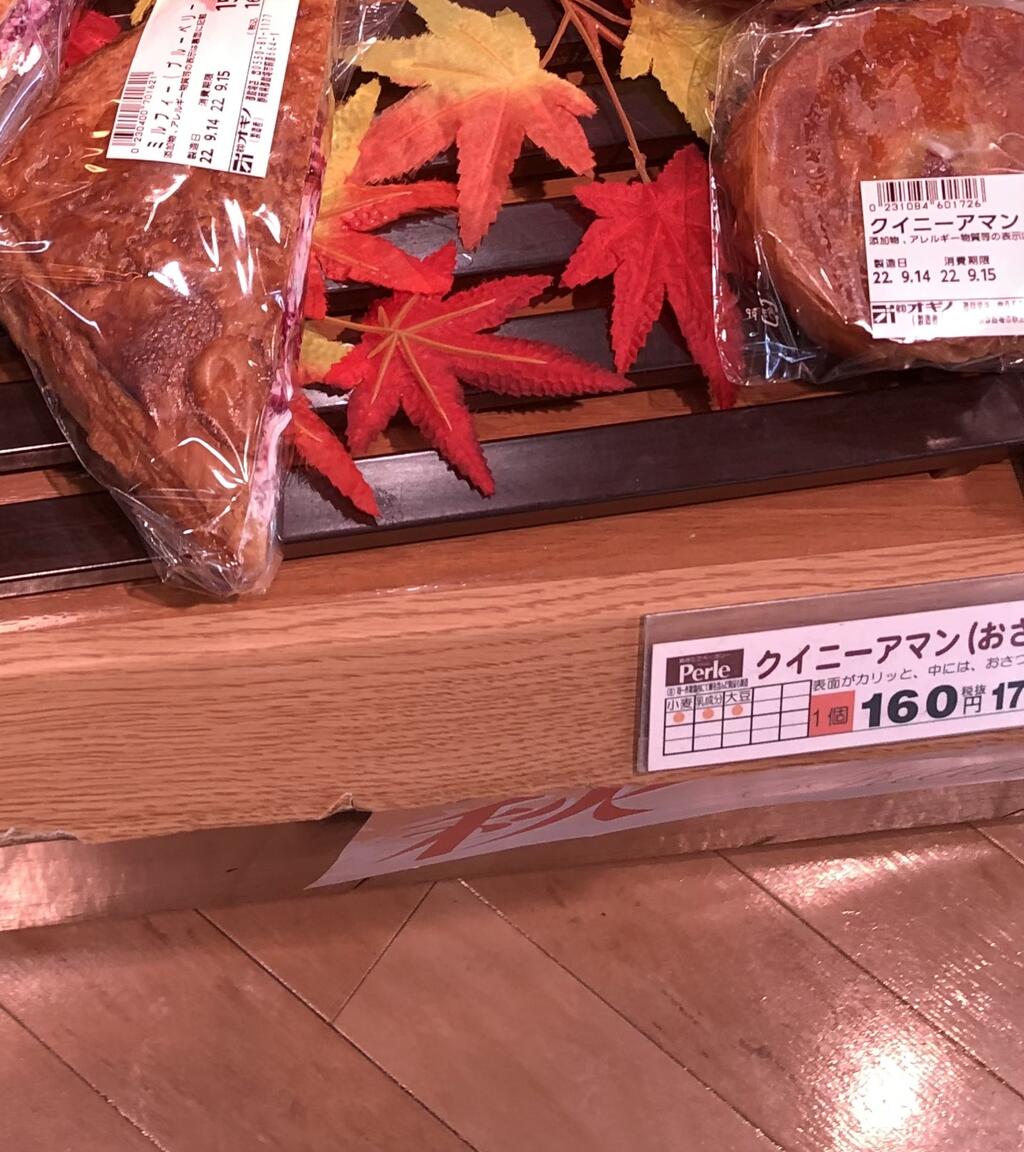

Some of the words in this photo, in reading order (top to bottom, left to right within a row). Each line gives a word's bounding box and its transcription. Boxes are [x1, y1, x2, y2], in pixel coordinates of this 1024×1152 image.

[203, 118, 220, 142] 9.14
[214, 70, 231, 91] 9.15
[869, 203, 876, 212] 0
[884, 202, 928, 212] 231084
[937, 200, 981, 210] 601726
[871, 214, 1019, 235] クイニーアマン
[874, 258, 908, 268] 製造日
[944, 255, 990, 266] 消費期限
[873, 271, 893, 284] 22.
[901, 269, 931, 283] 9.14
[940, 269, 960, 283] 22.
[968, 268, 997, 282] 9.15
[679, 660, 731, 684] Perle
[667, 698, 692, 710] 小麦
[696, 694, 723, 707] 乳成分
[726, 692, 751, 703] 大豆
[862, 684, 958, 728] 160
[963, 695, 982, 714] 円
